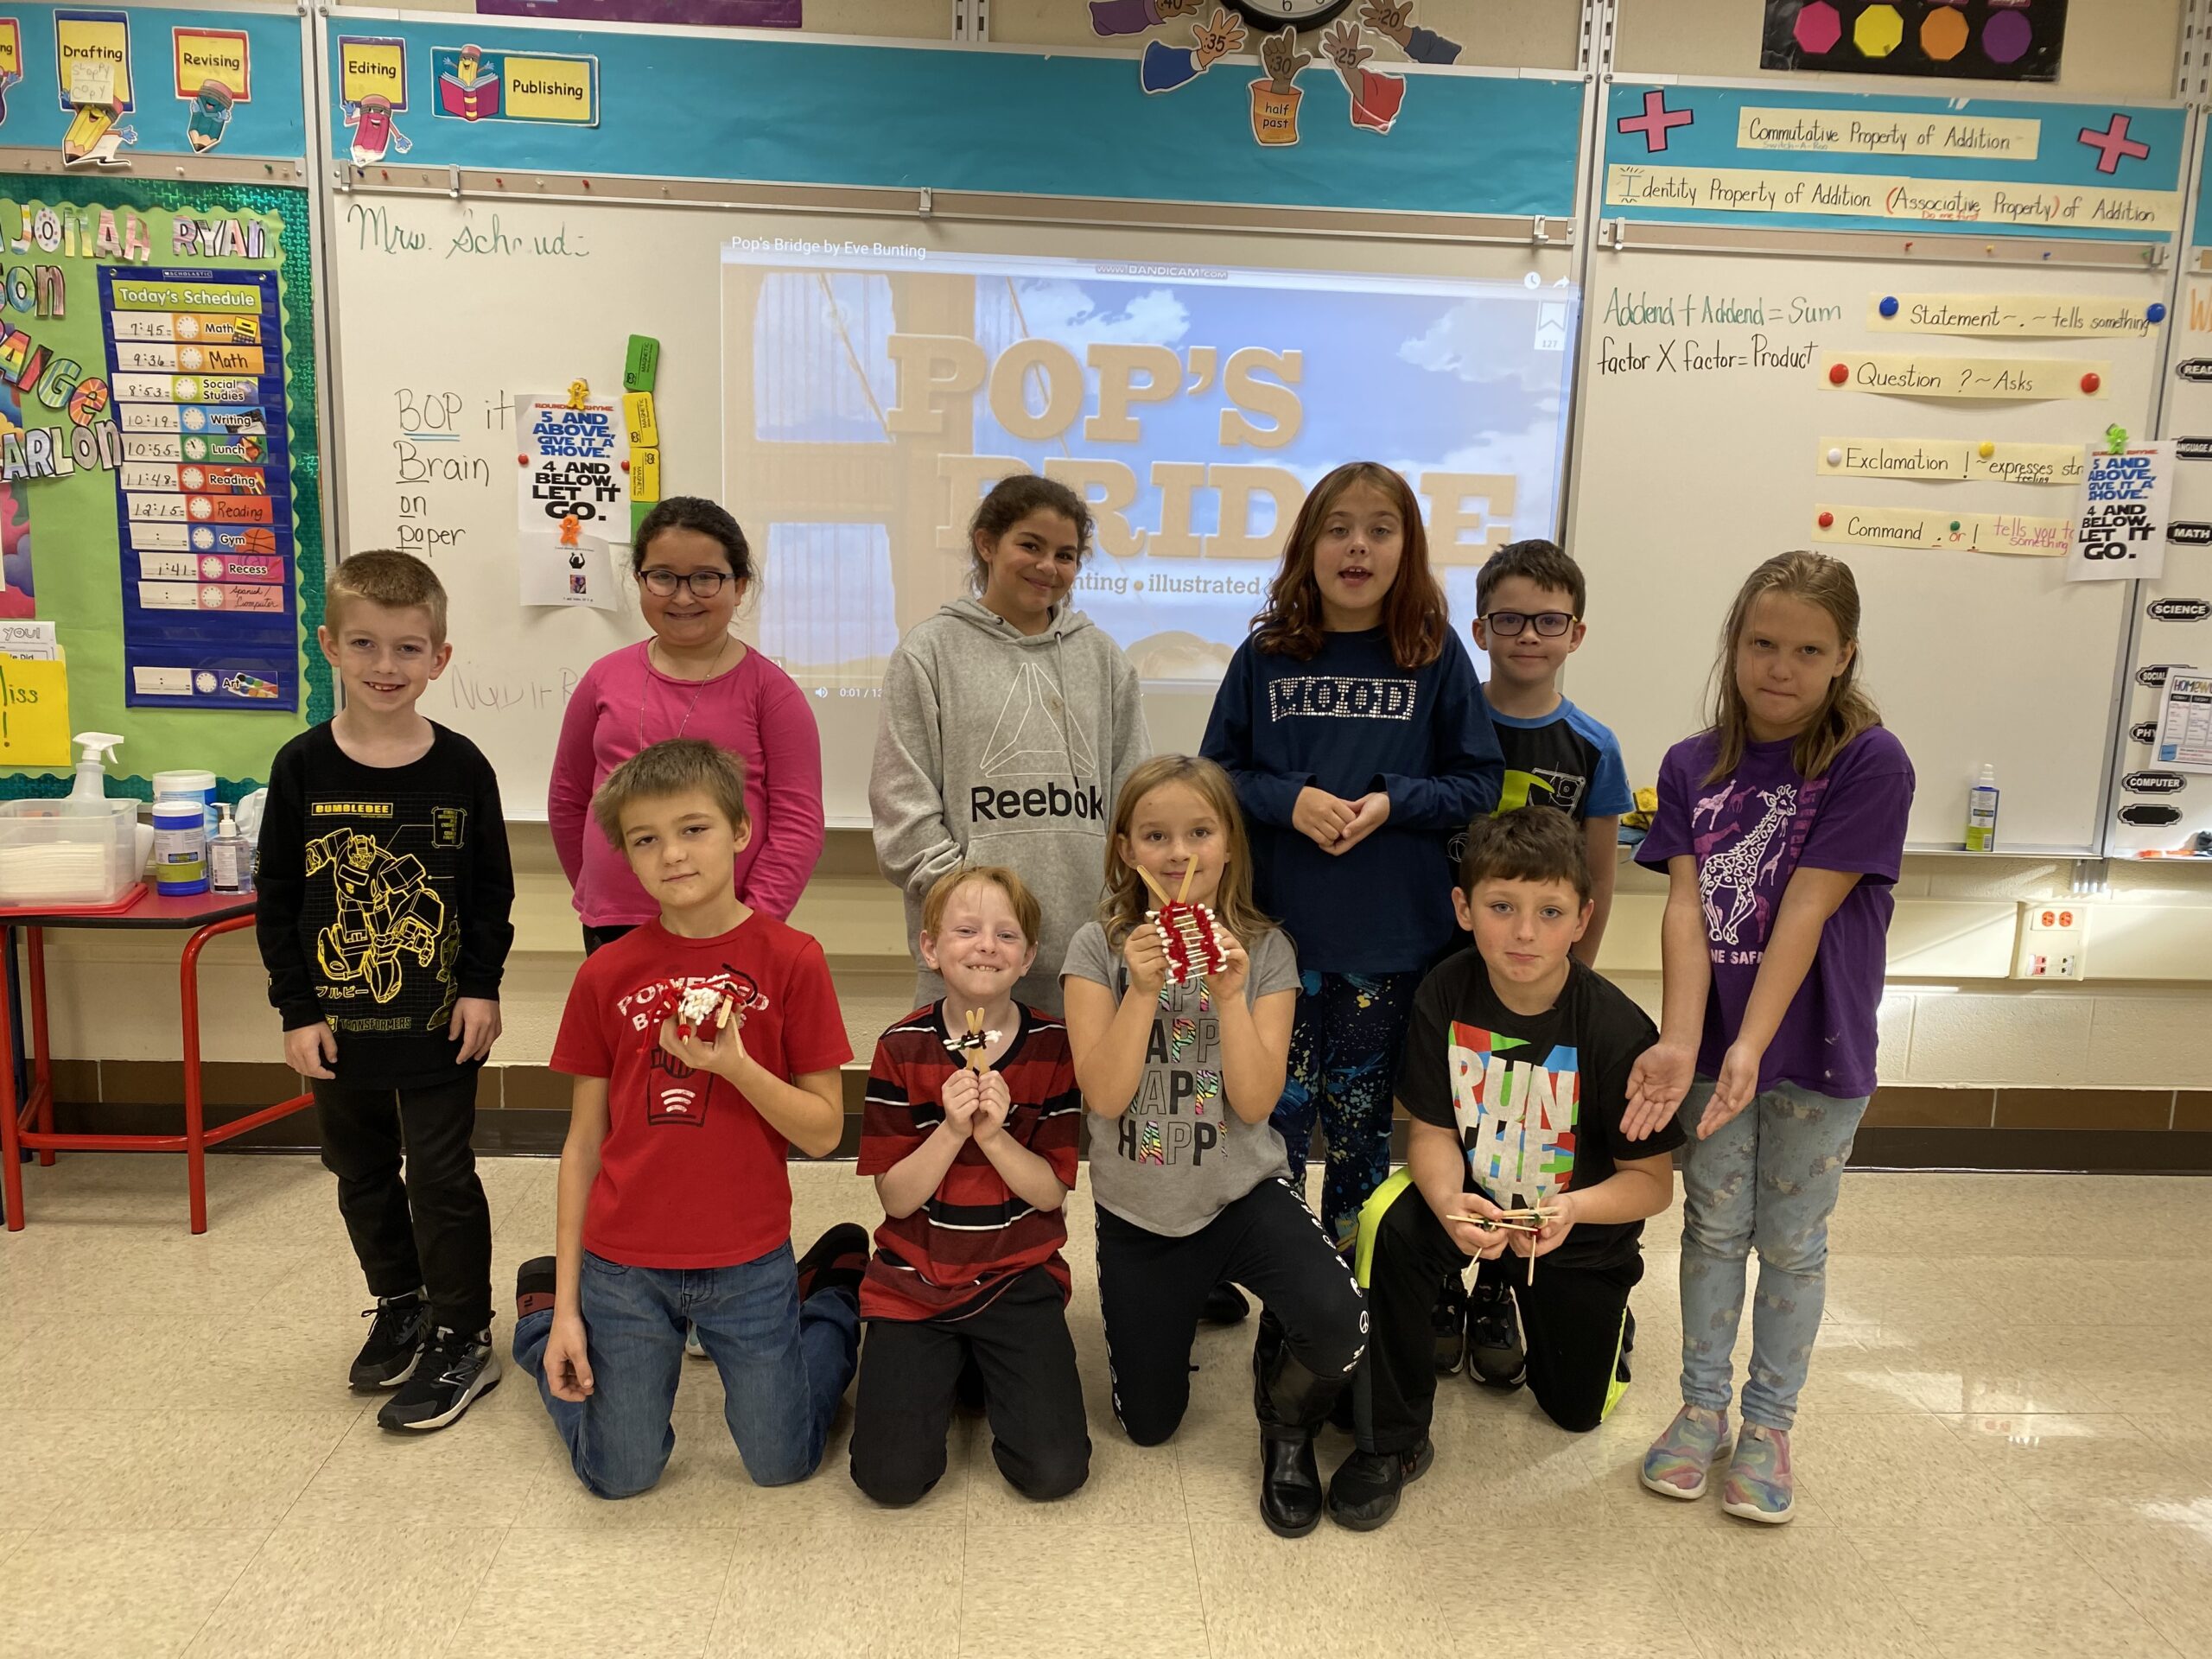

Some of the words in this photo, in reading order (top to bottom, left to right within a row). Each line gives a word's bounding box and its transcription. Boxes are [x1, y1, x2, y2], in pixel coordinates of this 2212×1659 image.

[1204, 33, 1226, 53] :35
[63, 46, 123, 62] Drafting
[183, 53, 240, 70] Revising
[1334, 48, 1357, 66] :25
[348, 60, 397, 78] Editing
[1270, 57, 1292, 74] :30
[512, 79, 583, 99] Publishing
[1265, 101, 1289, 117] half
[1262, 118, 1289, 130] past
[1750, 117, 1839, 143] Commutative
[1850, 120, 1907, 151] Property
[1916, 124, 1936, 145] of
[1944, 126, 2010, 150] Addition
[1618, 175, 1697, 205] Identity
[1710, 178, 1776, 210] Property
[1784, 182, 1805, 204] of
[1811, 183, 1872, 207] Addition
[2063, 196, 2083, 219] of
[2092, 198, 2156, 224] Addition
[732, 236, 771, 251] Pop's
[774, 238, 820, 256] Bridge
[823, 240, 840, 257] by
[844, 241, 868, 255] Eve
[873, 243, 926, 260] Bunting
[119, 288, 178, 306] Today's
[184, 290, 255, 306] Schedule
[1604, 287, 1675, 327] Addend
[1701, 296, 1764, 326] Addend
[1789, 296, 1841, 325] Sum
[130, 322, 164, 336] 7:45
[205, 323, 234, 334] Math
[2052, 307, 2084, 329] tells
[2090, 308, 2151, 337] something
[134, 353, 164, 366] 9:36
[209, 352, 249, 369] Math
[641, 342, 650, 373] MAGNETIC
[1597, 336, 1650, 375] factor
[1683, 340, 1737, 370] factor
[1751, 334, 1819, 369] Product
[203, 379, 237, 389] Social
[1857, 362, 1941, 388] Question
[1993, 370, 2033, 391] Asks
[129, 384, 162, 397] 8:53
[203, 391, 244, 401] Studies
[887, 334, 1303, 449] POP'S
[394, 388, 462, 431] BOP
[485, 390, 516, 430] it
[639, 398, 648, 429] MAGNETIC
[128, 414, 168, 427] 10:19
[211, 415, 251, 428] Writing
[541, 411, 553, 423] 5
[563, 412, 608, 425] AND
[532, 423, 615, 439] ABOVE,
[213, 444, 245, 454] Lunch
[537, 436, 575, 445] GIVE
[581, 438, 595, 447] IT
[602, 439, 614, 448] A
[2177, 443, 2209, 452] ANGUAGE
[128, 443, 174, 458] 10:55
[540, 445, 611, 458] SHOVE.
[393, 441, 489, 486] Brain
[542, 461, 556, 472] 4
[564, 462, 610, 474] AND
[1847, 448, 1948, 471] Exclamation
[1989, 461, 2053, 480] expresses
[2093, 458, 2101, 469] 5
[2107, 457, 2151, 469] AND
[126, 473, 171, 486] 11:48
[210, 474, 256, 488] Reading
[535, 473, 616, 488] BELOW,
[2088, 468, 2157, 481] ABOVE,
[2120, 481, 2135, 490] IT
[2141, 480, 2154, 489] A
[532, 485, 582, 500] LET
[596, 486, 621, 502] IT
[2088, 489, 2148, 500] SHOVE.
[135, 503, 180, 517] 12:15
[217, 501, 263, 520] Reading
[399, 495, 426, 516] on
[545, 500, 607, 521] GO.
[936, 454, 1516, 566] BRIDE
[2087, 505, 2096, 516] 4
[2103, 505, 2146, 516] AND
[1847, 517, 1923, 541] Command
[1949, 531, 1966, 542] or
[1994, 516, 2026, 537] tells
[2034, 527, 2056, 539] you
[2082, 516, 2152, 528] BELOW,
[219, 535, 245, 547] Gym
[397, 525, 466, 557] paper
[2078, 529, 2117, 543] LET
[2128, 526, 2156, 541] IT
[2174, 528, 2210, 538] MATH
[2009, 537, 2069, 556] something
[2083, 542, 2137, 560] GO.
[229, 564, 267, 575] Recess
[1148, 574, 1261, 594] illustrated
[2154, 605, 2206, 614] SCIENCE
[223, 678, 239, 688] Art
[839, 688, 860, 697] 0:01
[2129, 778, 2180, 788] COMPUTER
[315, 804, 389, 813] BUMBLEBEE
[971, 782, 1104, 823] Reebok
[340, 1017, 412, 1032] TRANSFORMERS
